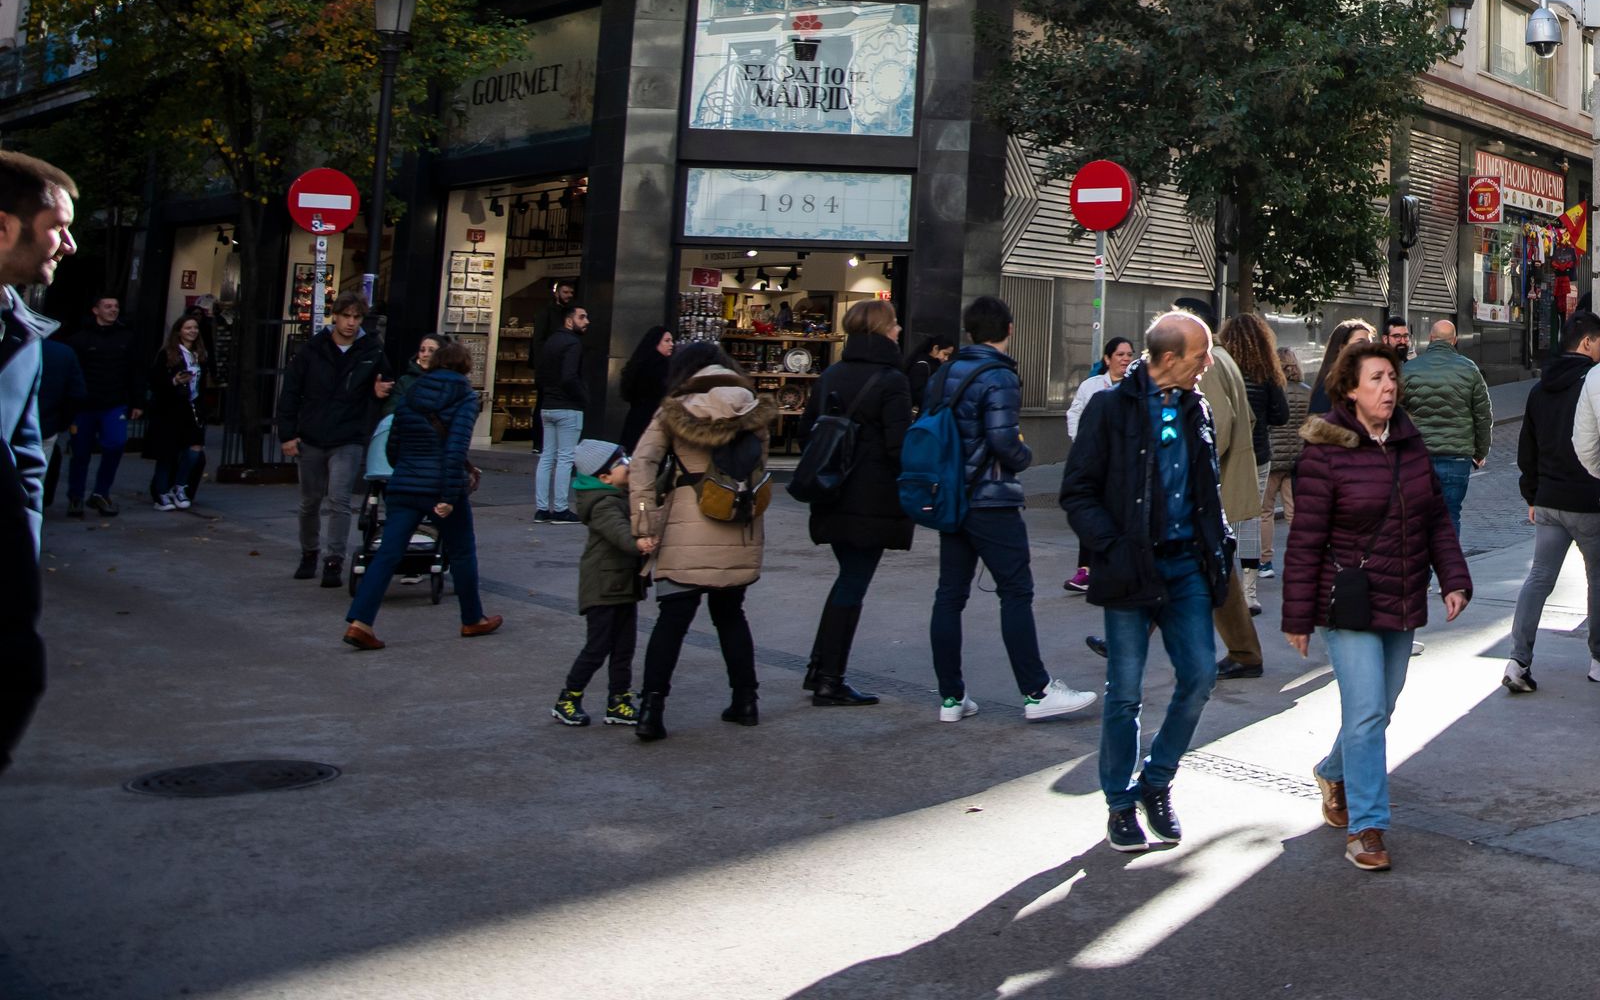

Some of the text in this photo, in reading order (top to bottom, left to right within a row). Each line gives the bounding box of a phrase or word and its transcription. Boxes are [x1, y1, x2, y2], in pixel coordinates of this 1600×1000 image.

[472, 63, 563, 106] GOURMET
[744, 64, 774, 81] EL
[782, 64, 845, 85] PATIO
[755, 84, 853, 113] MADRID
[1475, 153, 1564, 200] ALIMENTACION SOUVENIR
[760, 193, 839, 214] 1984
